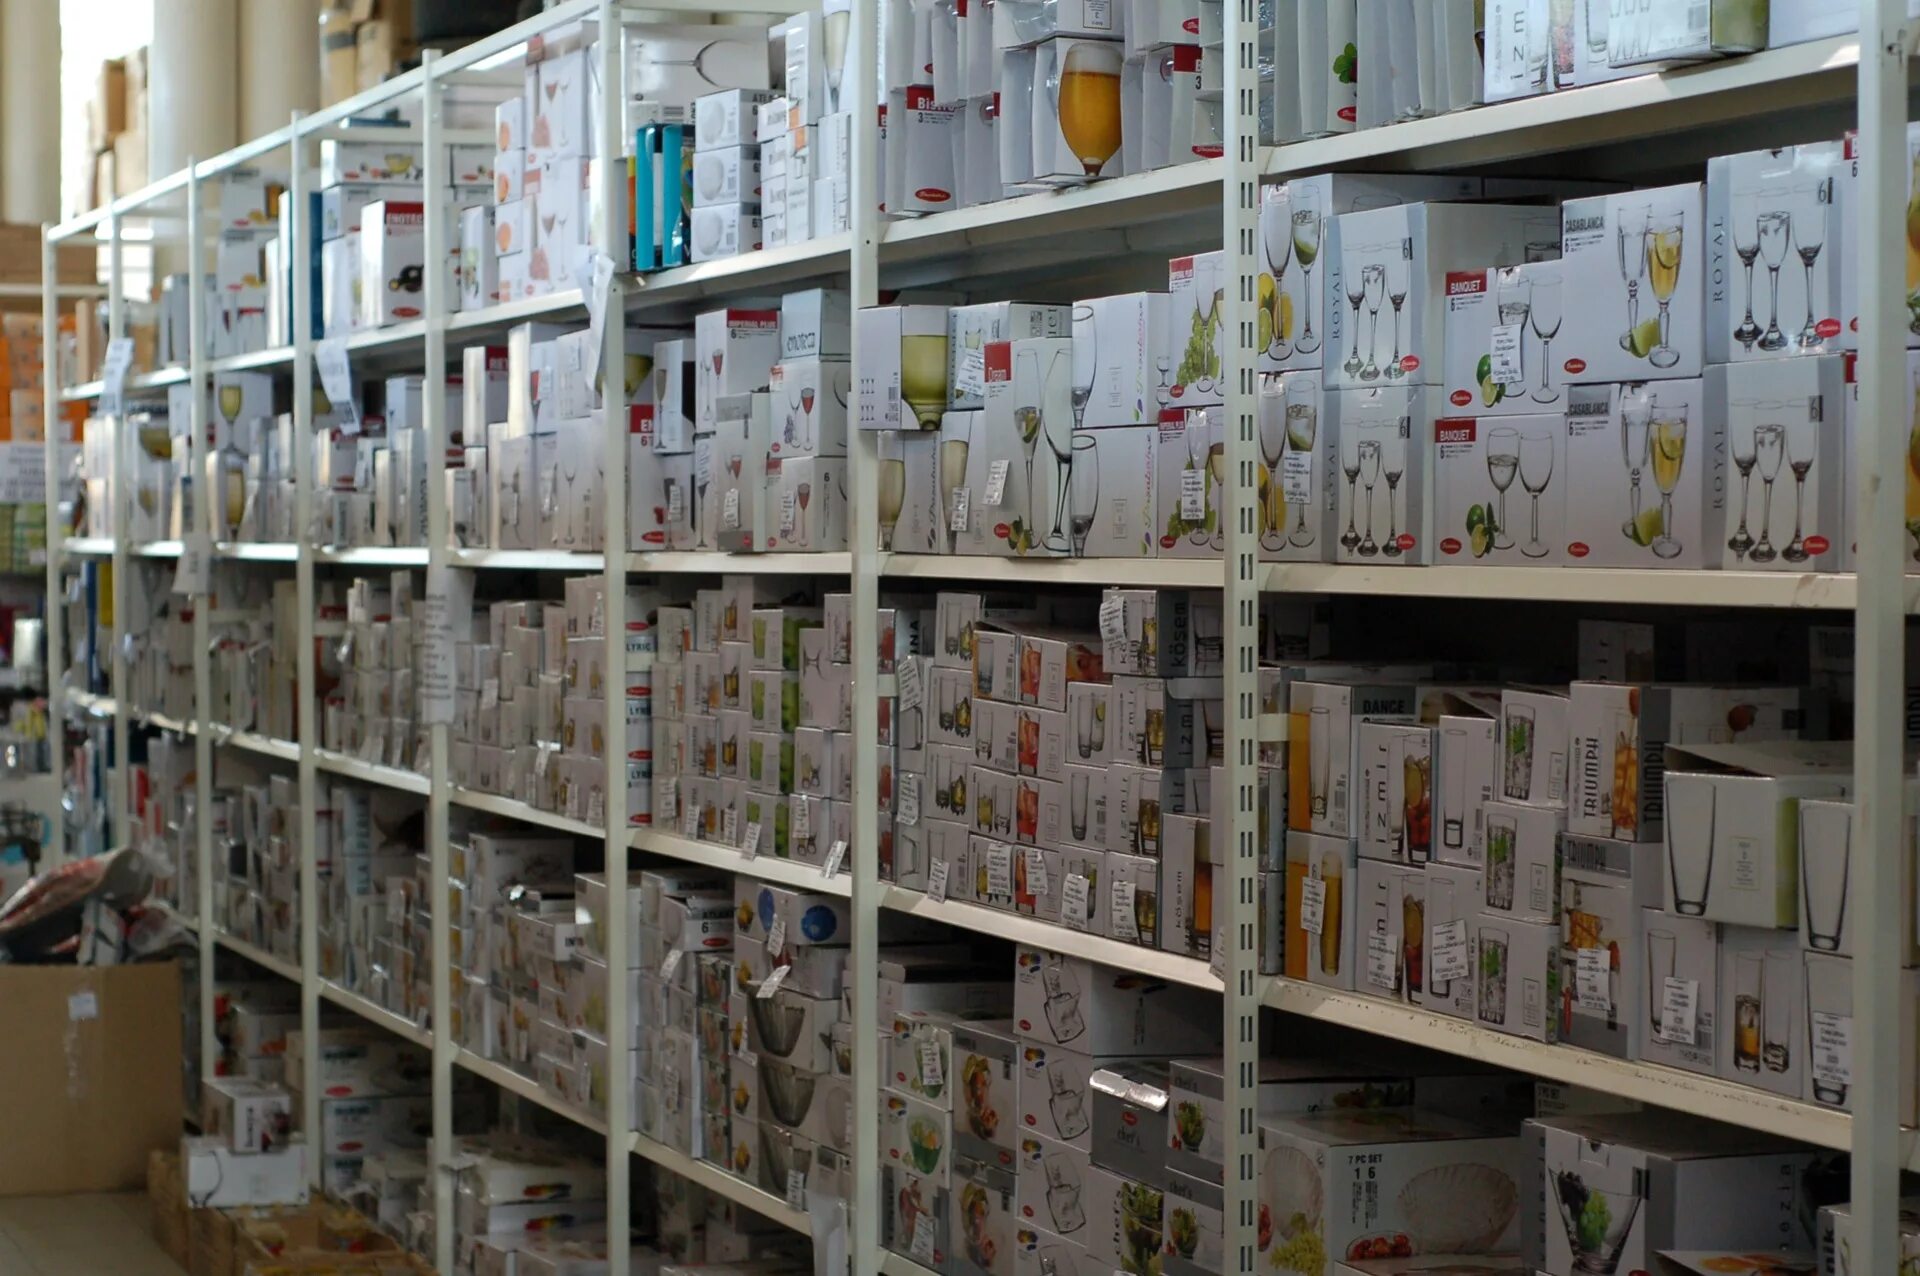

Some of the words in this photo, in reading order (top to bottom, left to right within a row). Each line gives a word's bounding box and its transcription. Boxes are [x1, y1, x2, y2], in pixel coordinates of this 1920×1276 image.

[917, 112, 924, 123] 3
[1818, 181, 1827, 202] 6
[1565, 216, 1604, 233] CASABLANCA
[1712, 216, 1724, 302] ROYAL
[1450, 279, 1481, 294] BANQUET
[1332, 266, 1340, 340] ROYAL
[730, 329, 737, 339] 6
[1569, 402, 1608, 416] CASABLANCA
[1440, 429, 1470, 442] BANQUET
[1713, 424, 1724, 509] ROYAL
[1171, 601, 1187, 668] kösem
[1363, 699, 1404, 715] DANCE
[1584, 737, 1599, 819] TRIUMPH
[1567, 840, 1607, 871] TRIUMPH
[701, 921, 709, 933] 6
[1348, 1156, 1353, 1165] 7
[1355, 1155, 1366, 1164] PC
[1368, 1154, 1383, 1164] SET
[1355, 1168, 1360, 1179] 1
[1368, 1166, 1376, 1179] 6
